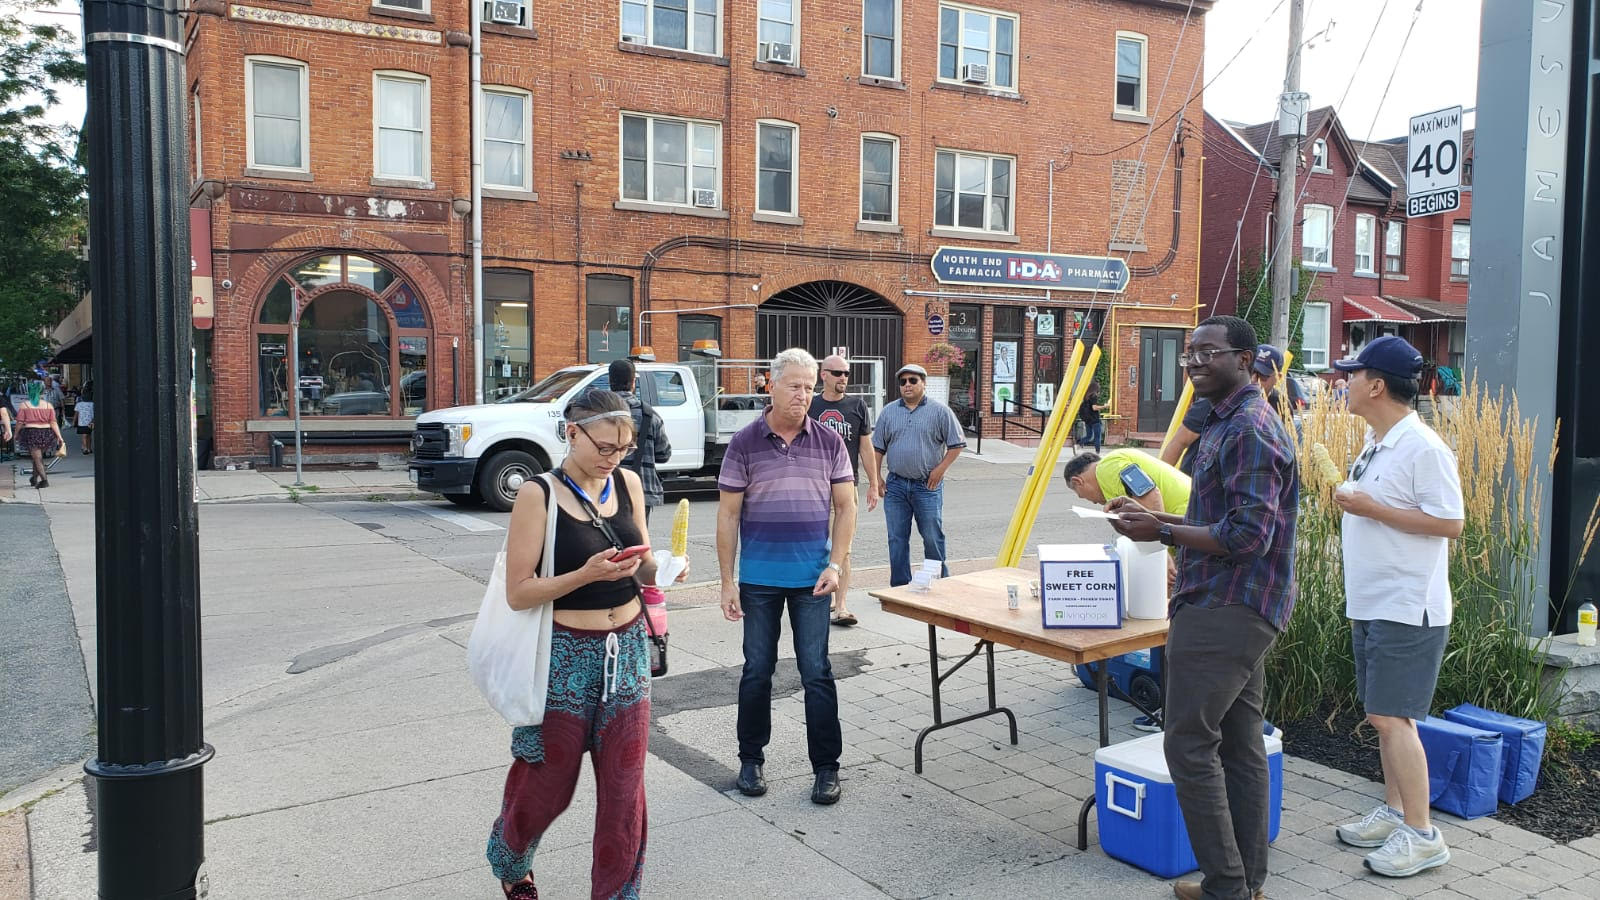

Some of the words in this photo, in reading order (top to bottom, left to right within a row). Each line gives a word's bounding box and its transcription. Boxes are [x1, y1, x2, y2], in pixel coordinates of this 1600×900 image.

[1412, 114, 1458, 136] MAXIMUM
[1411, 139, 1458, 178] 40
[1410, 192, 1456, 214] BEGINS
[942, 255, 978, 265] NORTH
[983, 257, 1002, 266] END
[949, 267, 1002, 277] FARMACIA
[1067, 268, 1121, 279] PHARMACY
[959, 312, 967, 325] 3
[547, 410, 561, 418] 135
[1066, 570, 1094, 578] FREE
[1045, 583, 1082, 591] SWEET
[1085, 583, 1116, 591] CORN
